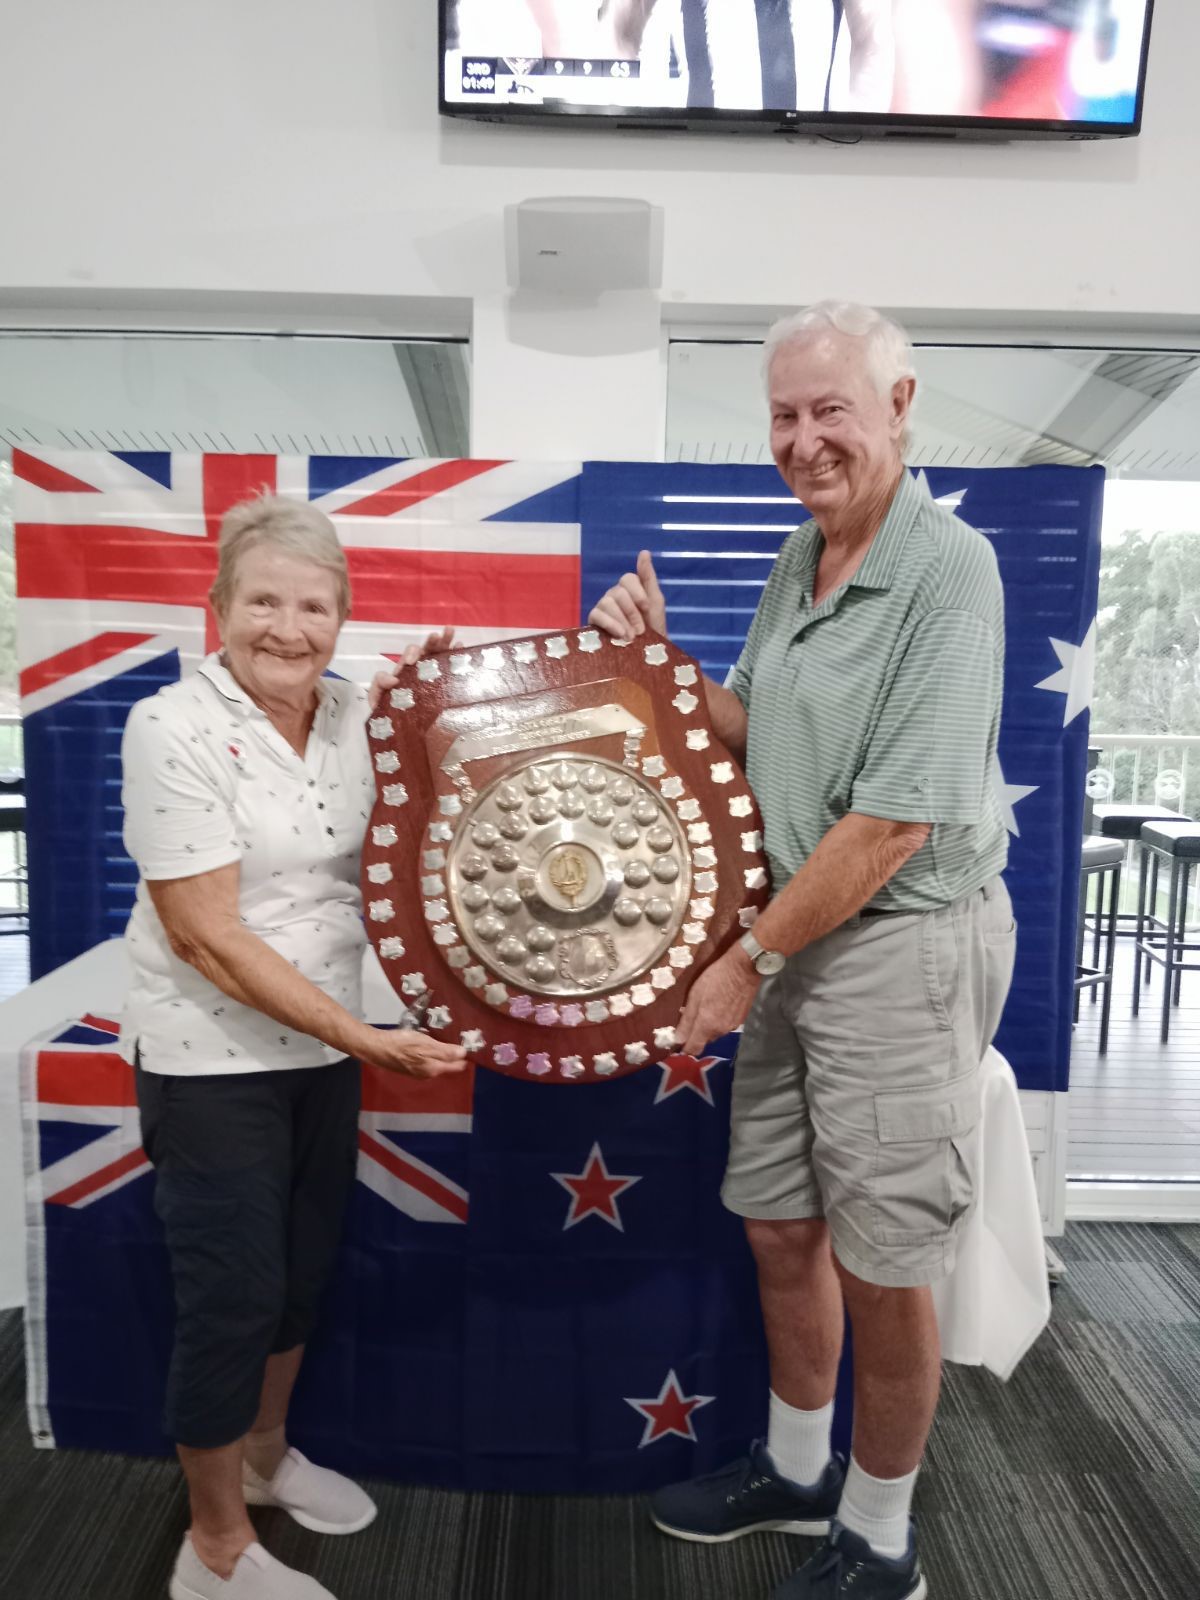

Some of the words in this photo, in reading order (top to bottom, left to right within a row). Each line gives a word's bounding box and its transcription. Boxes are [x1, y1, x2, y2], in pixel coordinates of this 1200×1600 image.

[554, 60, 564, 75] 9
[582, 61, 593, 75] 9
[610, 61, 631, 78] 63
